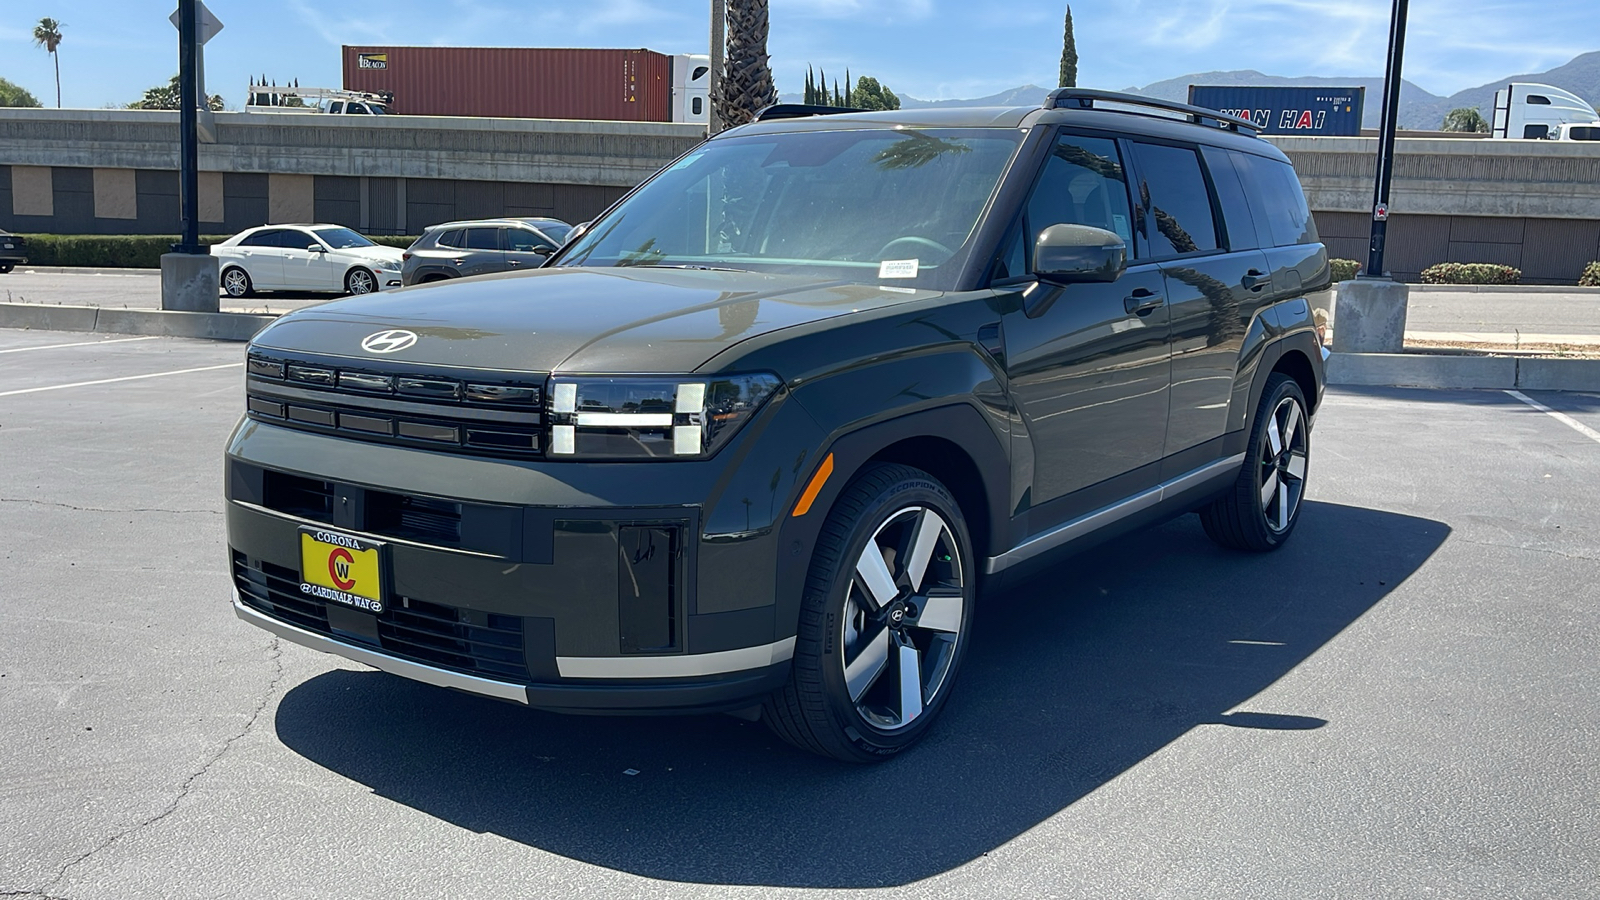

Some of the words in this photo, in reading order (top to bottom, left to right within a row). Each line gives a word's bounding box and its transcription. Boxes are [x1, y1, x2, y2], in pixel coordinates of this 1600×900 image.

[1279, 109, 1326, 129] HAI
[316, 531, 360, 549] CORONA
[311, 586, 353, 605] CARDINALE
[354, 596, 371, 609] WAY
